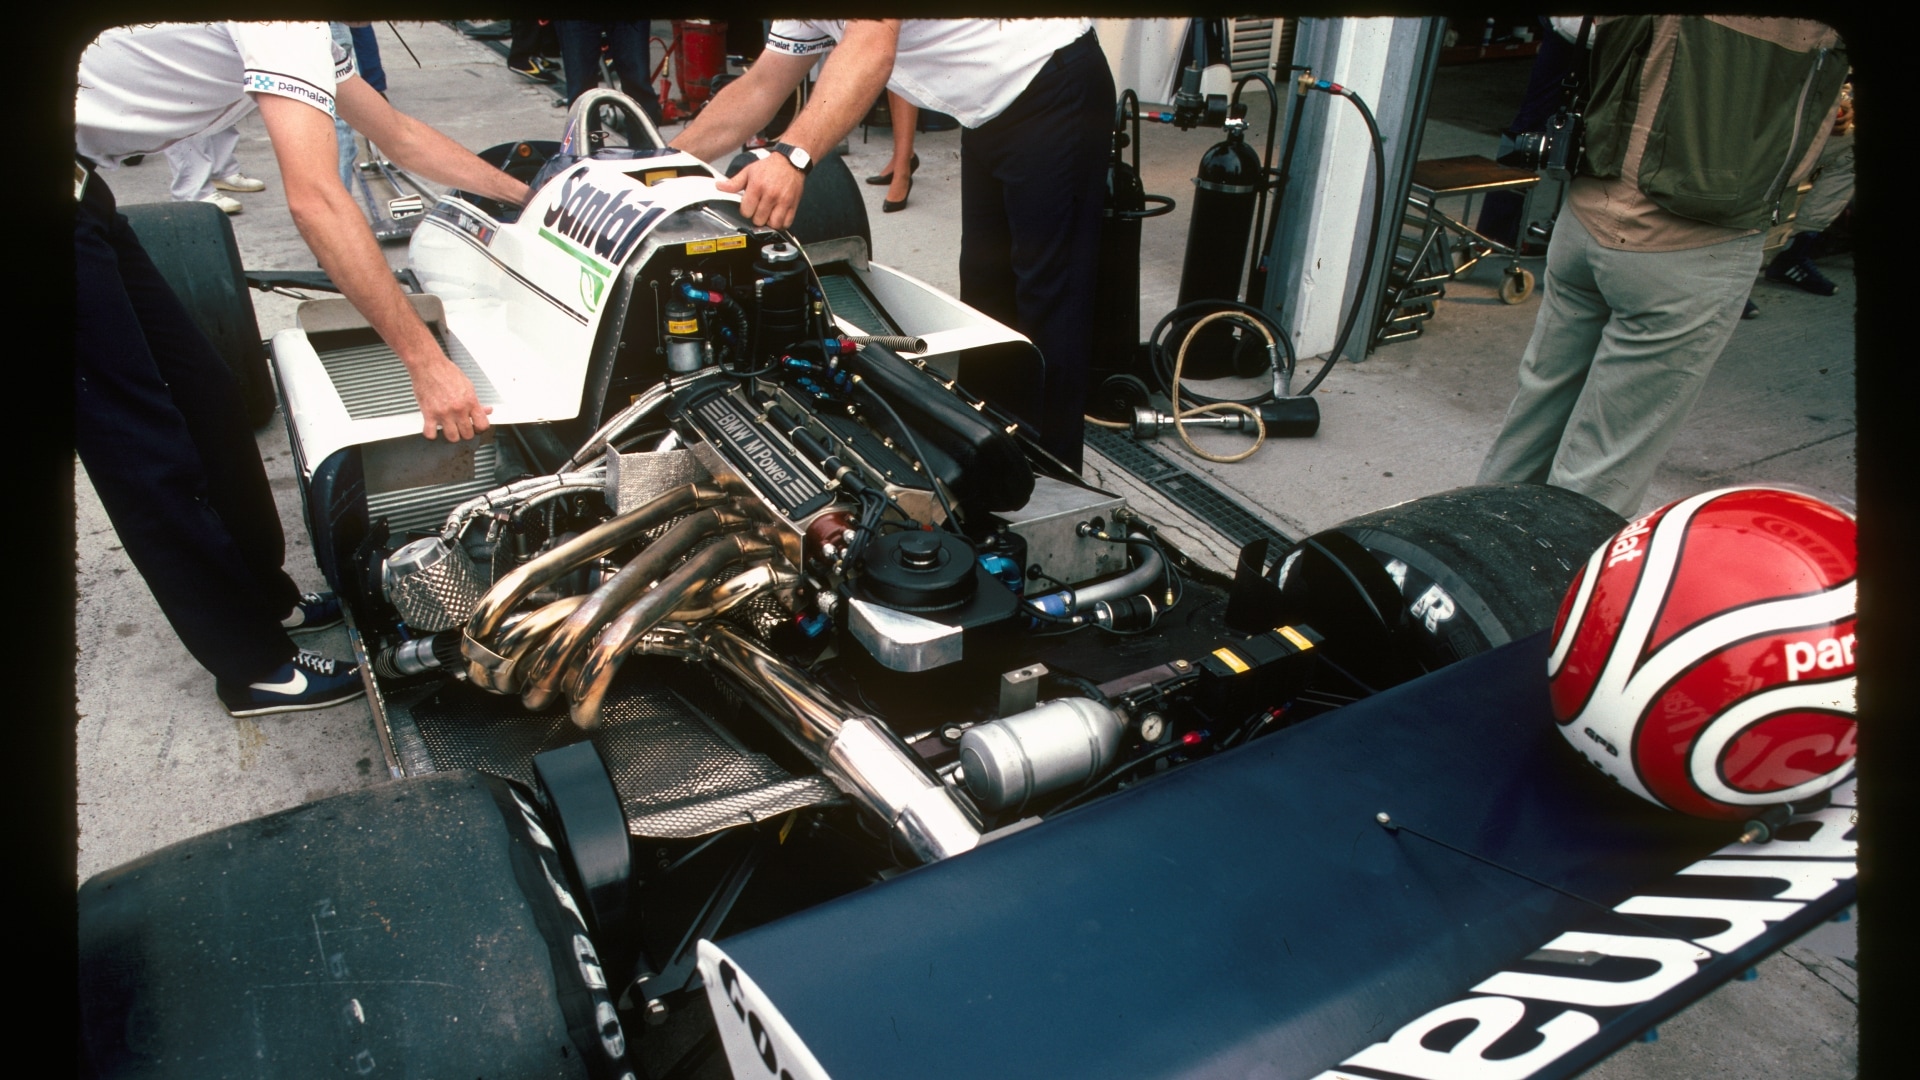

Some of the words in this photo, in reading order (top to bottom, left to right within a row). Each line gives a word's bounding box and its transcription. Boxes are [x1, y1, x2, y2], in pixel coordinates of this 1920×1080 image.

[278, 81, 328, 106] parmalat
[718, 403, 753, 442] BMW
[742, 438, 761, 455] M
[752, 448, 792, 484] Power
[1608, 511, 1656, 568] alat
[1784, 633, 1857, 681] par
[1308, 785, 1858, 1080] arma
